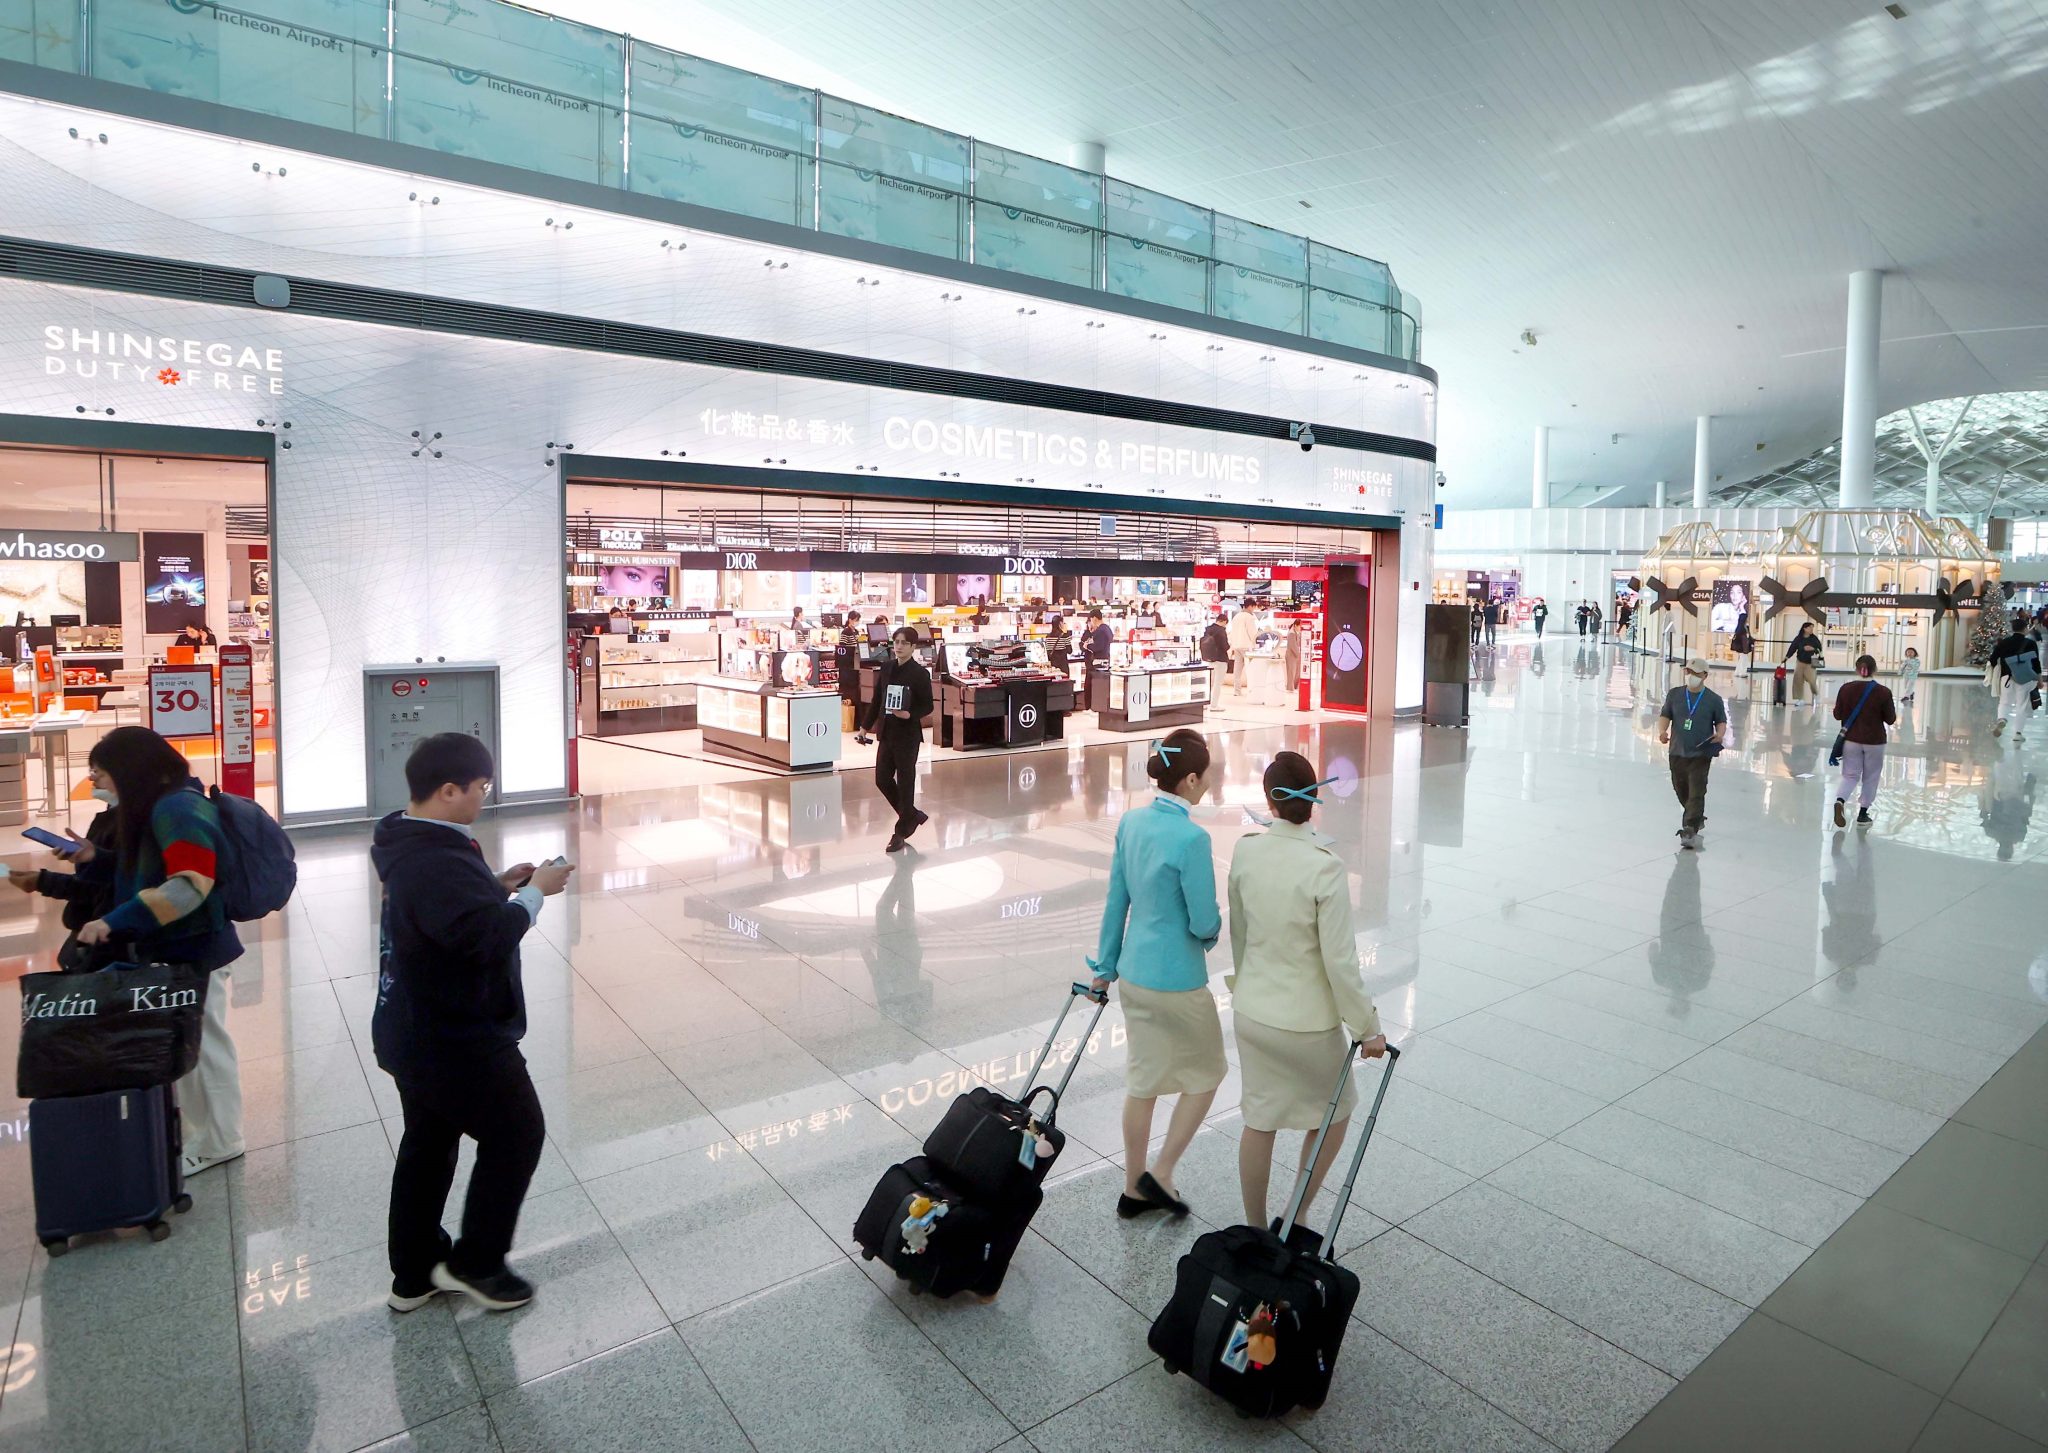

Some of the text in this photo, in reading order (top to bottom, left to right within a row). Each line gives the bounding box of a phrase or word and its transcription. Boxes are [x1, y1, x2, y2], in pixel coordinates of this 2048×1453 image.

[212, 7, 345, 53] Incheon Airport
[487, 77, 590, 113] Incheon Airport
[704, 132, 747, 151] Incheon
[879, 176, 915, 193] Incheon
[1023, 213, 1055, 228] Incheon
[1147, 243, 1197, 264] Incheon Airport
[44, 325, 284, 373] SHINSEGAE
[45, 356, 284, 396] DUTY FREE
[883, 416, 1261, 485] COSMETICS & PERFUMES
[1332, 467, 1393, 486] SHINSEGAE
[599, 529, 645, 542] POLA
[599, 555, 676, 565] HELENA RUBINSTEIN
[725, 552, 758, 570] DIOR
[1003, 557, 1047, 575] DIOR
[1246, 566, 1272, 579] SK-II
[1855, 596, 1899, 606] CHANEL
[636, 634, 660, 643] DIOR
[155, 689, 200, 713] 30
[128, 985, 198, 1013] Kim
